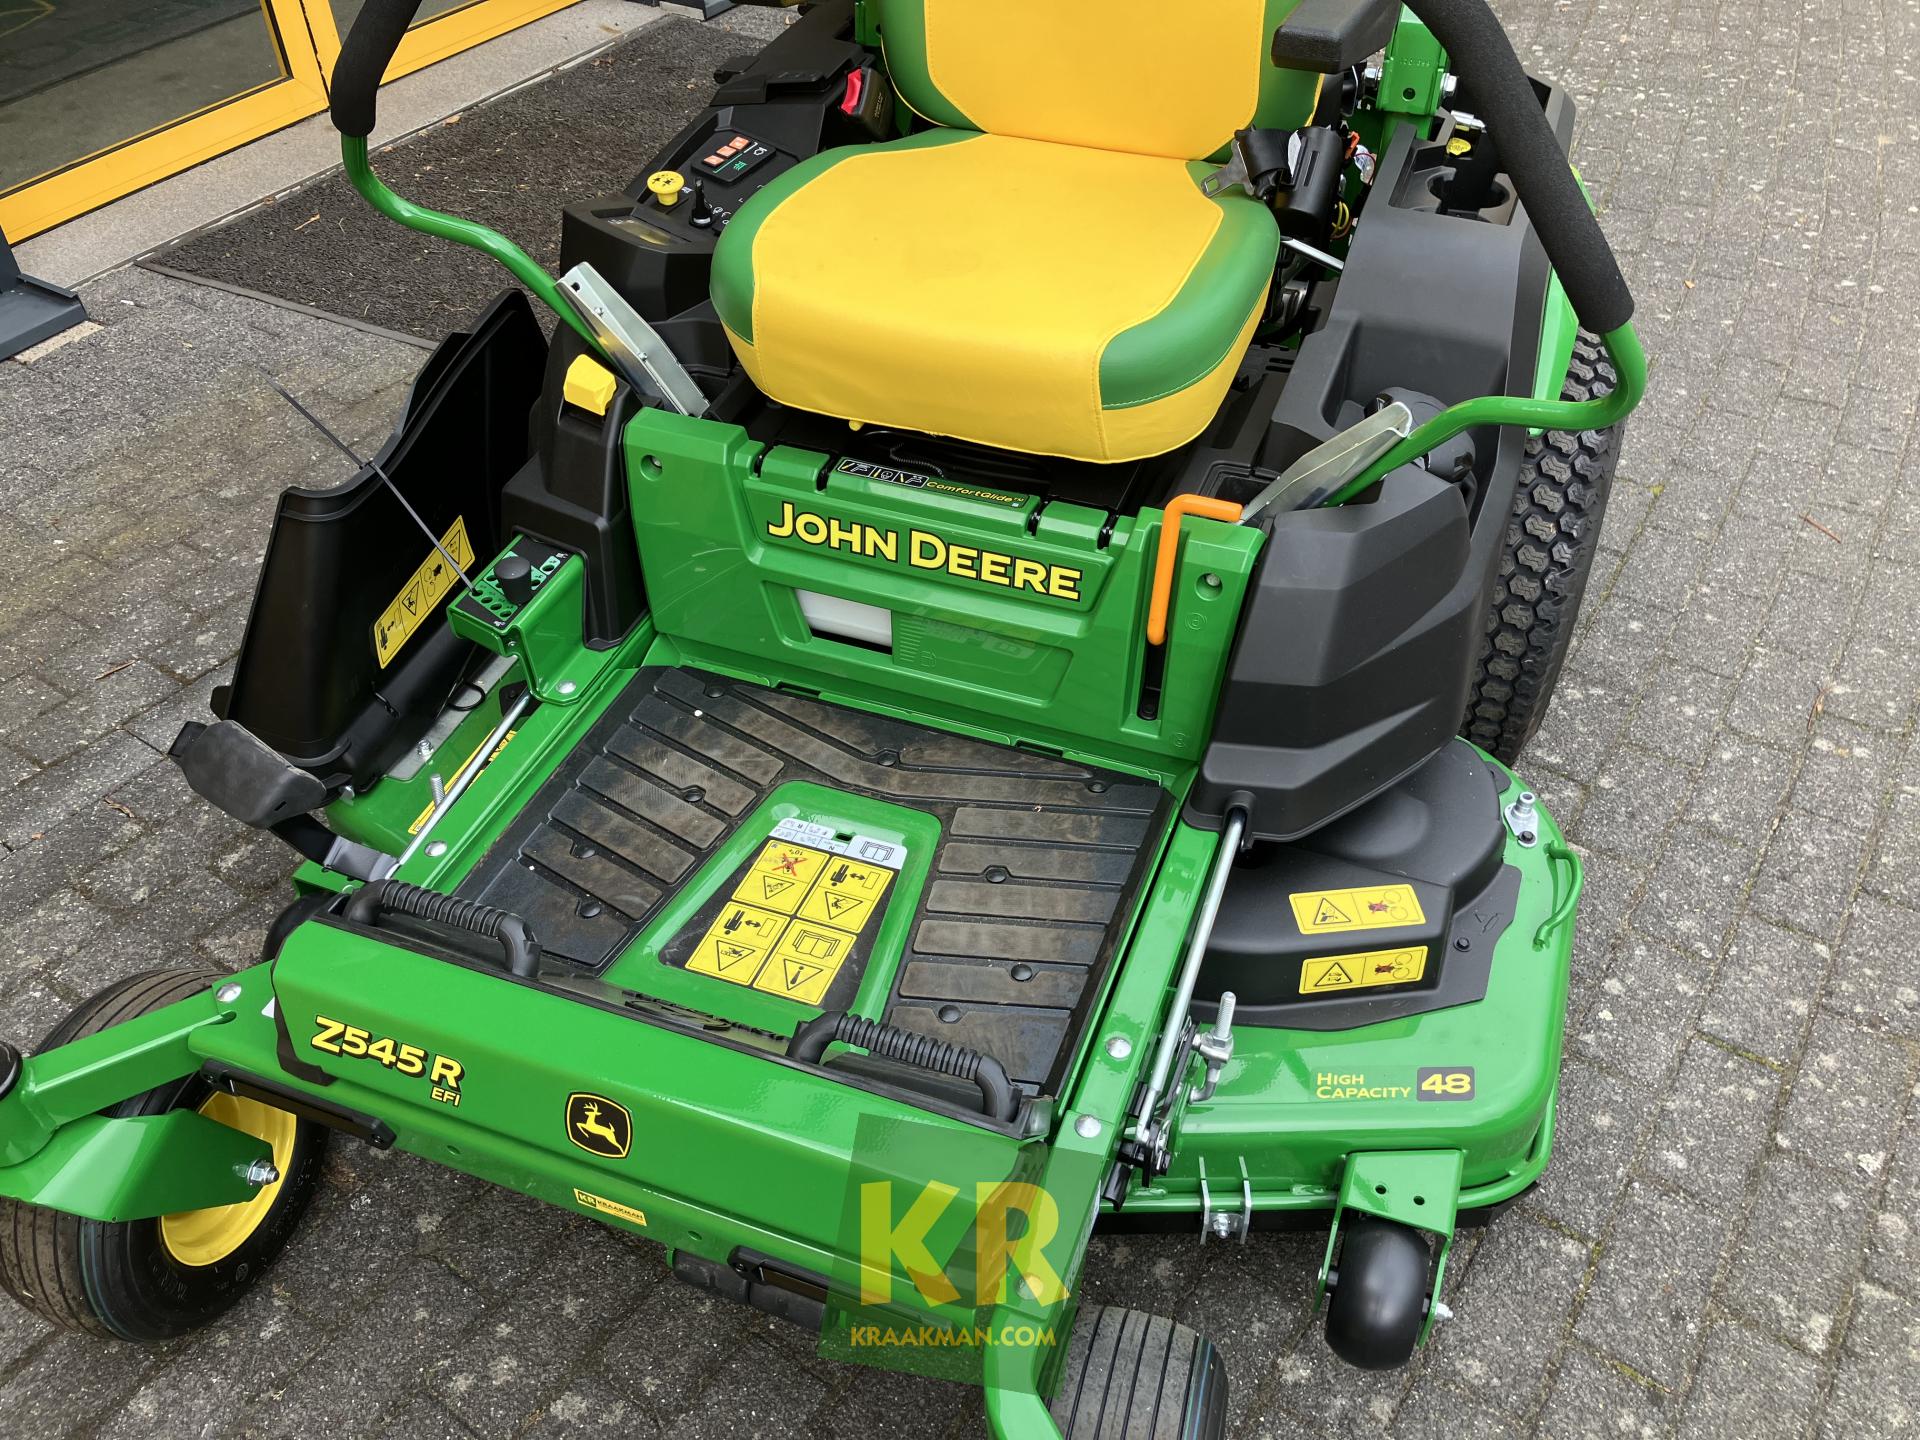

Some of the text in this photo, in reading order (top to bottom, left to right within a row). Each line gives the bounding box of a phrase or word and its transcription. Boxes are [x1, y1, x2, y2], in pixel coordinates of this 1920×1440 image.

[767, 501, 1083, 603] JOHN DEERE
[310, 1014, 466, 1092] Z545 R
[1316, 1072, 1365, 1086] HIGH
[1421, 1073, 1472, 1094] 48
[431, 1088, 461, 1107] EFI
[1315, 1086, 1412, 1099] CAPACITY
